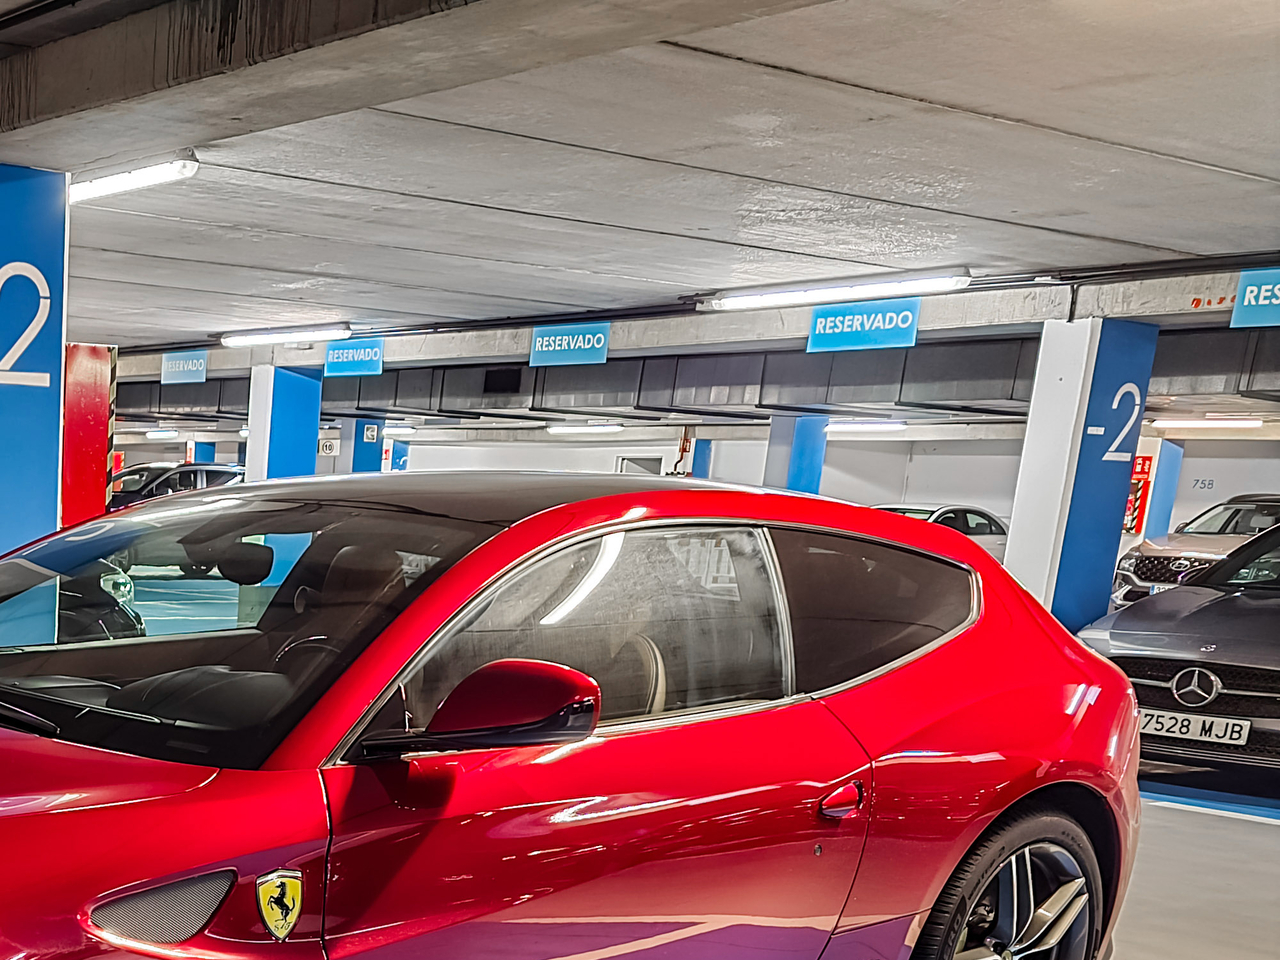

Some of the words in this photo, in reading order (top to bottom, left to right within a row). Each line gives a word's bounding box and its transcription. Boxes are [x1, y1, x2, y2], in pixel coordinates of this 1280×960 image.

[815, 309, 914, 335] RESERVADO
[534, 332, 606, 352] RESERVADO
[163, 358, 205, 372] RESERVADO
[327, 347, 380, 363] RESERVADO
[1086, 382, 1141, 462] -2
[1192, 479, 1215, 490] 758
[1141, 713, 1191, 735] 7528
[1199, 720, 1244, 741] MJB
